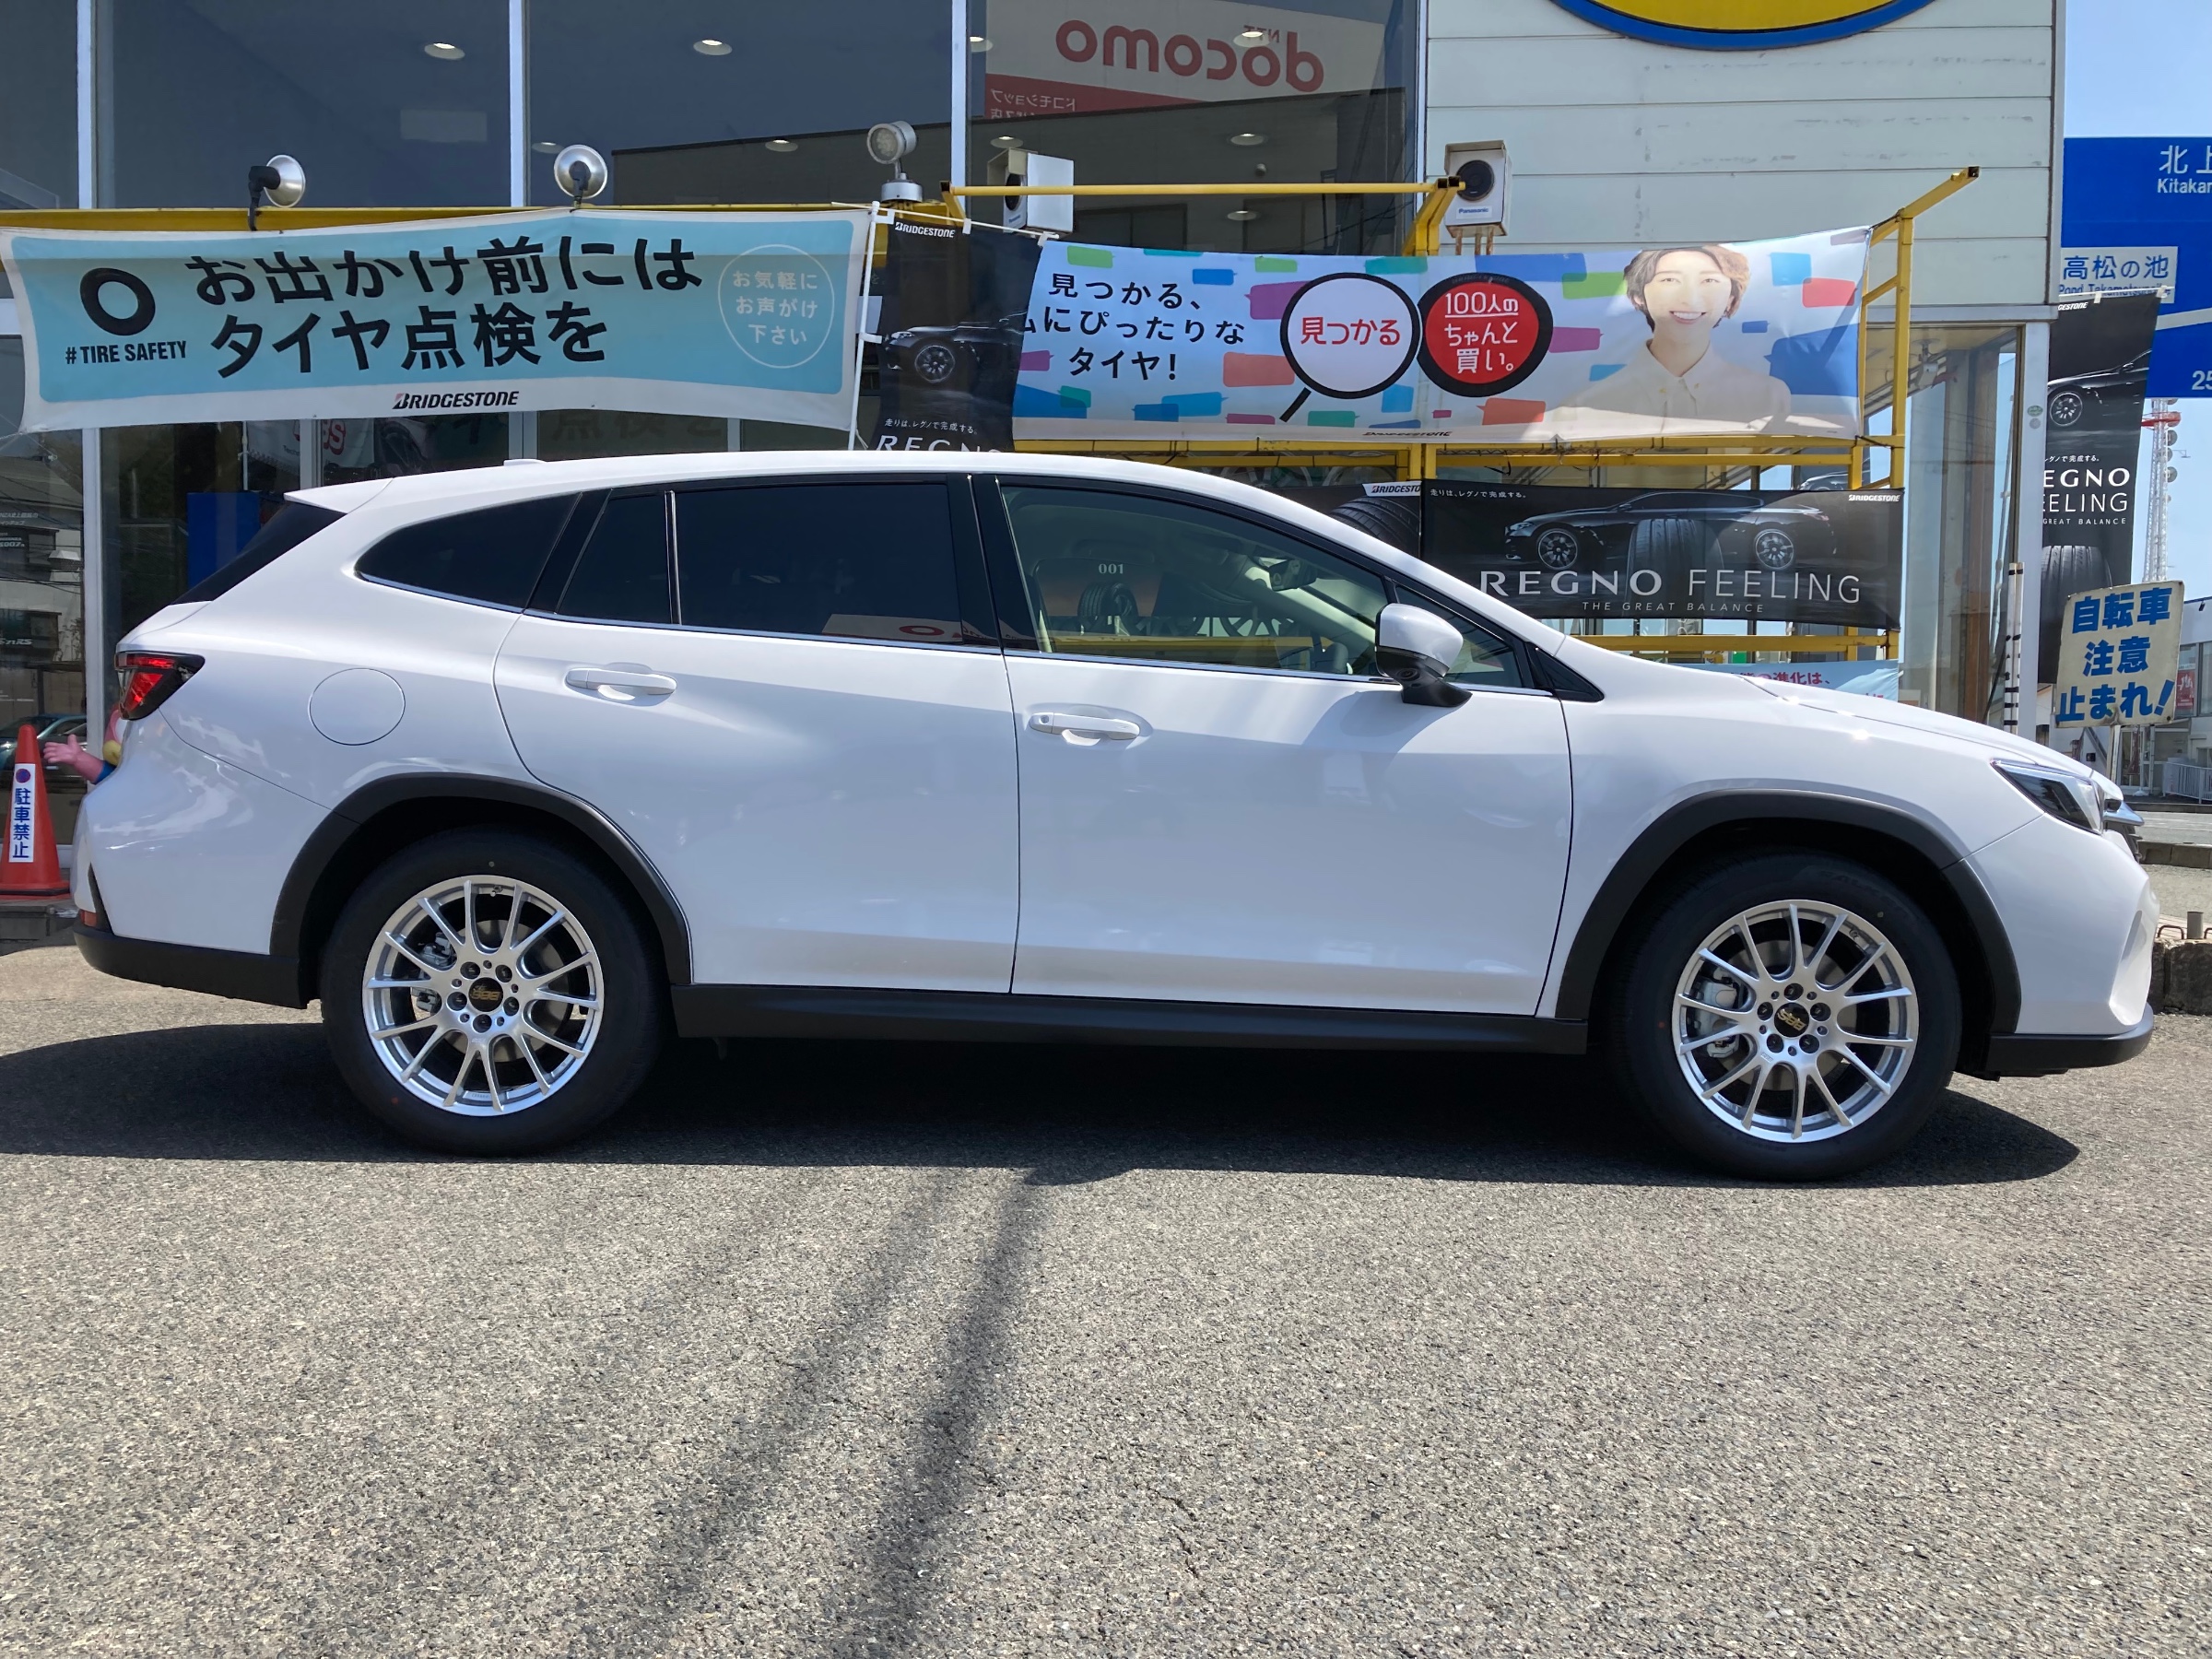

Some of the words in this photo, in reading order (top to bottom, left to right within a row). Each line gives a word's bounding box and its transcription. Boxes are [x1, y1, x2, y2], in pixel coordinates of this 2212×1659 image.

[895, 221, 956, 238] BRIDGESTONE
[185, 236, 704, 305] お出かけ前には
[733, 270, 818, 290] お気軽に
[2063, 254, 2169, 280] 高松の池
[1048, 273, 1201, 310] 見つかる、
[1444, 291, 1519, 315] 100人の
[735, 295, 818, 319] お声がけ
[211, 301, 606, 378] タイヤ点検を
[747, 324, 806, 346] 下さい
[1301, 317, 1401, 346] 見つかる
[1444, 321, 1518, 347] ちゃんと
[124, 340, 186, 361] SAFETY
[1456, 347, 1513, 373] 買い。
[1069, 347, 1176, 381] タイヤ!
[393, 390, 519, 410] BRIDGESTONE
[877, 435, 1003, 453] REG
[1848, 494, 1900, 502] BRIDGESTONE
[2078, 517, 2126, 525] BALANCE
[1098, 563, 1124, 575] 001
[1480, 570, 1663, 596] REGNO
[1688, 569, 1861, 604] FEELING
[1582, 602, 1611, 611] THE
[1622, 602, 1675, 612] GREAT
[1687, 603, 1764, 613] BALANCE
[2072, 587, 2172, 634] 自転車
[2083, 635, 2151, 677] 注意
[2055, 679, 2175, 722] 止まれ!
[12, 788, 31, 859] 駐車禁止
